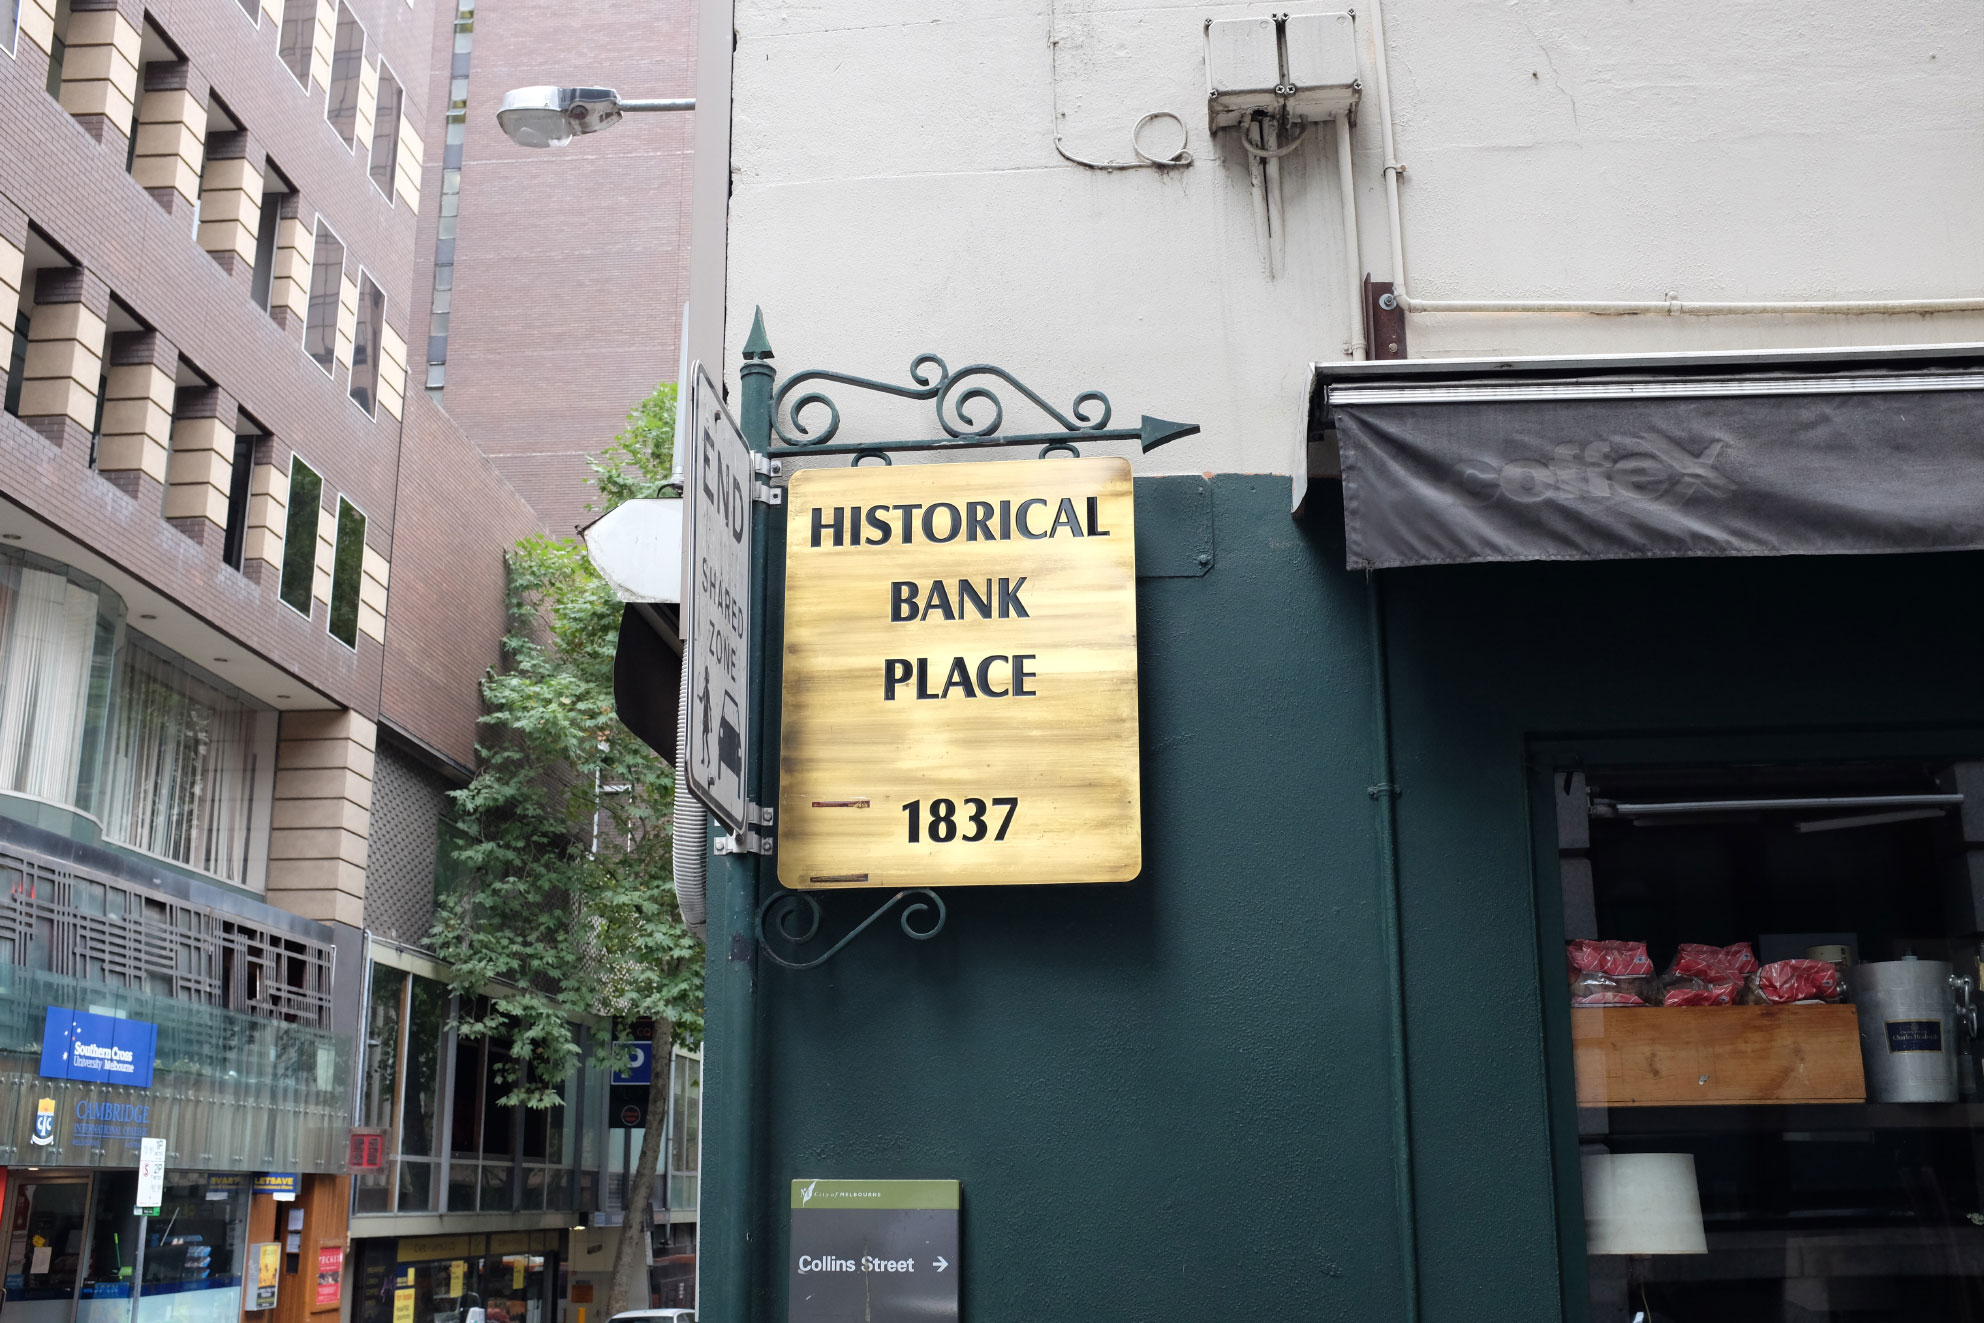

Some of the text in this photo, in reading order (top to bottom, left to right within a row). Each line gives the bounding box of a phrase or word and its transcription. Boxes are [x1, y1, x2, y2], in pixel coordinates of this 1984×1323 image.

[703, 424, 744, 545] END
[810, 495, 1110, 548] HISTORICAL
[702, 556, 743, 640] SHARED
[890, 576, 1030, 623] BANK
[708, 618, 737, 682] ZONE
[883, 654, 1037, 701] PLACE
[902, 797, 1019, 844] 1837
[73, 1056, 134, 1072] University Melbourne
[74, 1041, 133, 1062] Southern Cross
[76, 1100, 150, 1123] CAMBRIDGE
[798, 1255, 915, 1272] Collins Street
